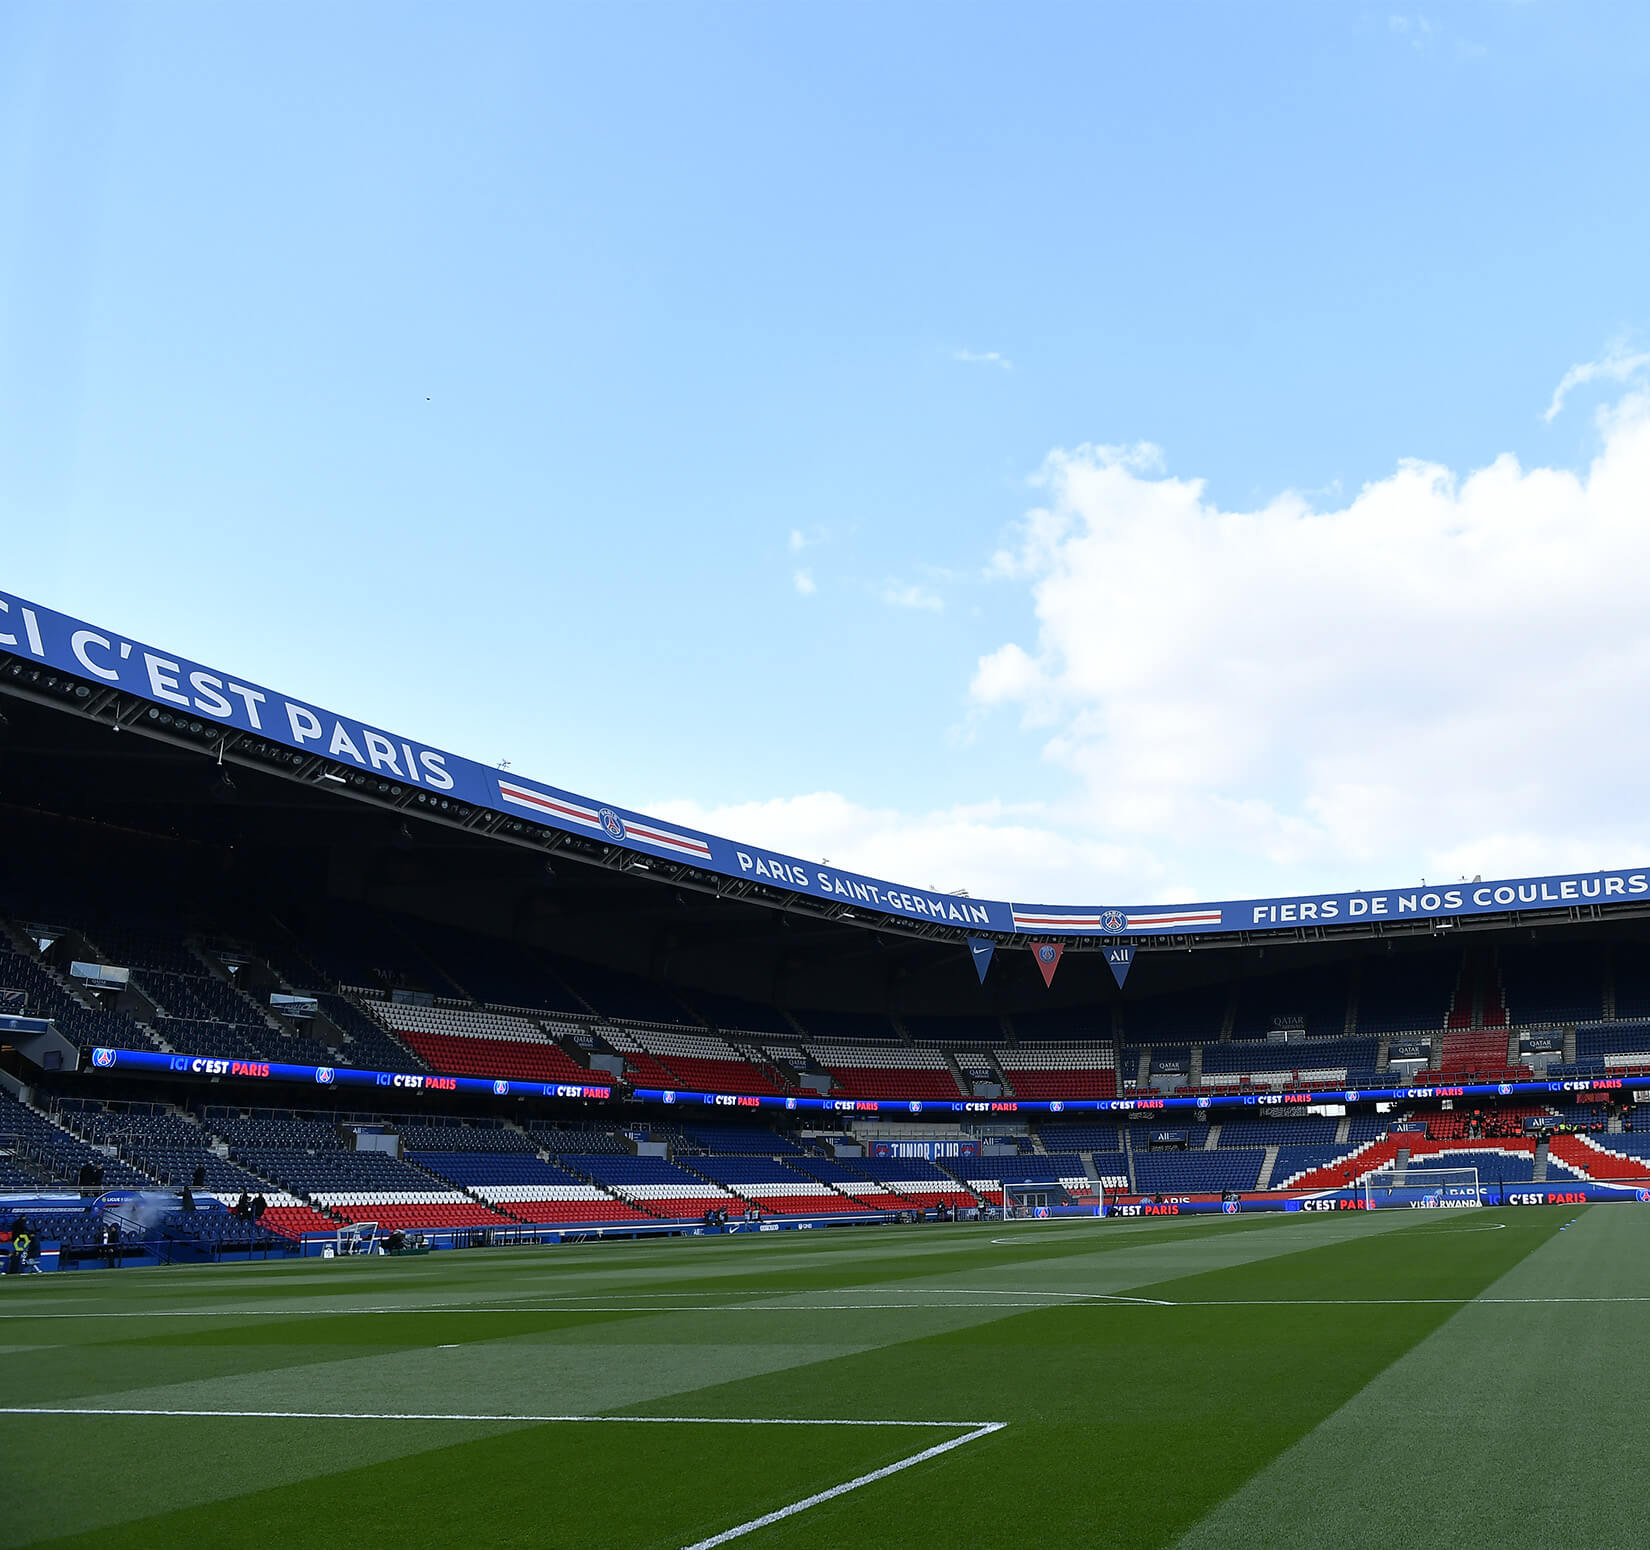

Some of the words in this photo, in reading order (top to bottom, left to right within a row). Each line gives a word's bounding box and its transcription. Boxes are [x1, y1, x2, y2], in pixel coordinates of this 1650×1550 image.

[70, 629, 266, 730] C'EST
[284, 702, 455, 791] PARIS
[736, 851, 809, 887] PARIS
[817, 872, 990, 924] SAINT-GERMAIN
[1253, 900, 1339, 924] FIERS
[1349, 896, 1388, 916] DE
[1398, 891, 1463, 913] NOS
[1472, 874, 1649, 906] COULEURS
[1273, 1016, 1304, 1026] QATAR
[1529, 1040, 1552, 1048] QATAR
[170, 1057, 188, 1071] ICI
[192, 1058, 230, 1074] C'EST
[231, 1062, 270, 1078] PARIS
[1159, 1062, 1180, 1070] QATAR
[969, 1069, 989, 1077] QATAR
[376, 1073, 391, 1086] ICI
[393, 1074, 424, 1088] C'EST
[425, 1076, 457, 1090] PARIS
[1548, 1082, 1561, 1091] ICI
[1563, 1081, 1590, 1091] C'EST
[1592, 1079, 1623, 1089] PARIS
[542, 1085, 555, 1096] ICI
[557, 1085, 582, 1098] C'EST
[583, 1087, 610, 1099] PARIS
[1392, 1090, 1405, 1098] ICI
[1407, 1088, 1433, 1098] C'EST
[1435, 1087, 1464, 1097] PARIS
[703, 1095, 714, 1105] ICI
[715, 1095, 737, 1106] C'EST
[737, 1096, 760, 1107] PARIS
[1096, 1102, 1109, 1110] ICI
[1110, 1101, 1135, 1110] C'EST
[1137, 1100, 1164, 1109] PARIS
[1243, 1096, 1256, 1105] ICI
[1257, 1095, 1283, 1105] C'EST
[1284, 1094, 1312, 1103] PARIS
[822, 1101, 833, 1110] ICI
[834, 1101, 855, 1111] C'EST
[856, 1102, 879, 1111] PARIS
[951, 1103, 963, 1111] ICI
[965, 1102, 990, 1111] C'EST
[991, 1103, 1018, 1111] PARIS
[891, 1143, 930, 1160] JUNIOR
[1409, 1201, 1434, 1209] VISIT
[1439, 1200, 1483, 1209] RWANDA
[1509, 1194, 1543, 1205] C'EST
[1547, 1192, 1587, 1204] PARIS
[1145, 1204, 1179, 1216] PARIS
[1303, 1199, 1337, 1211] C'EST
